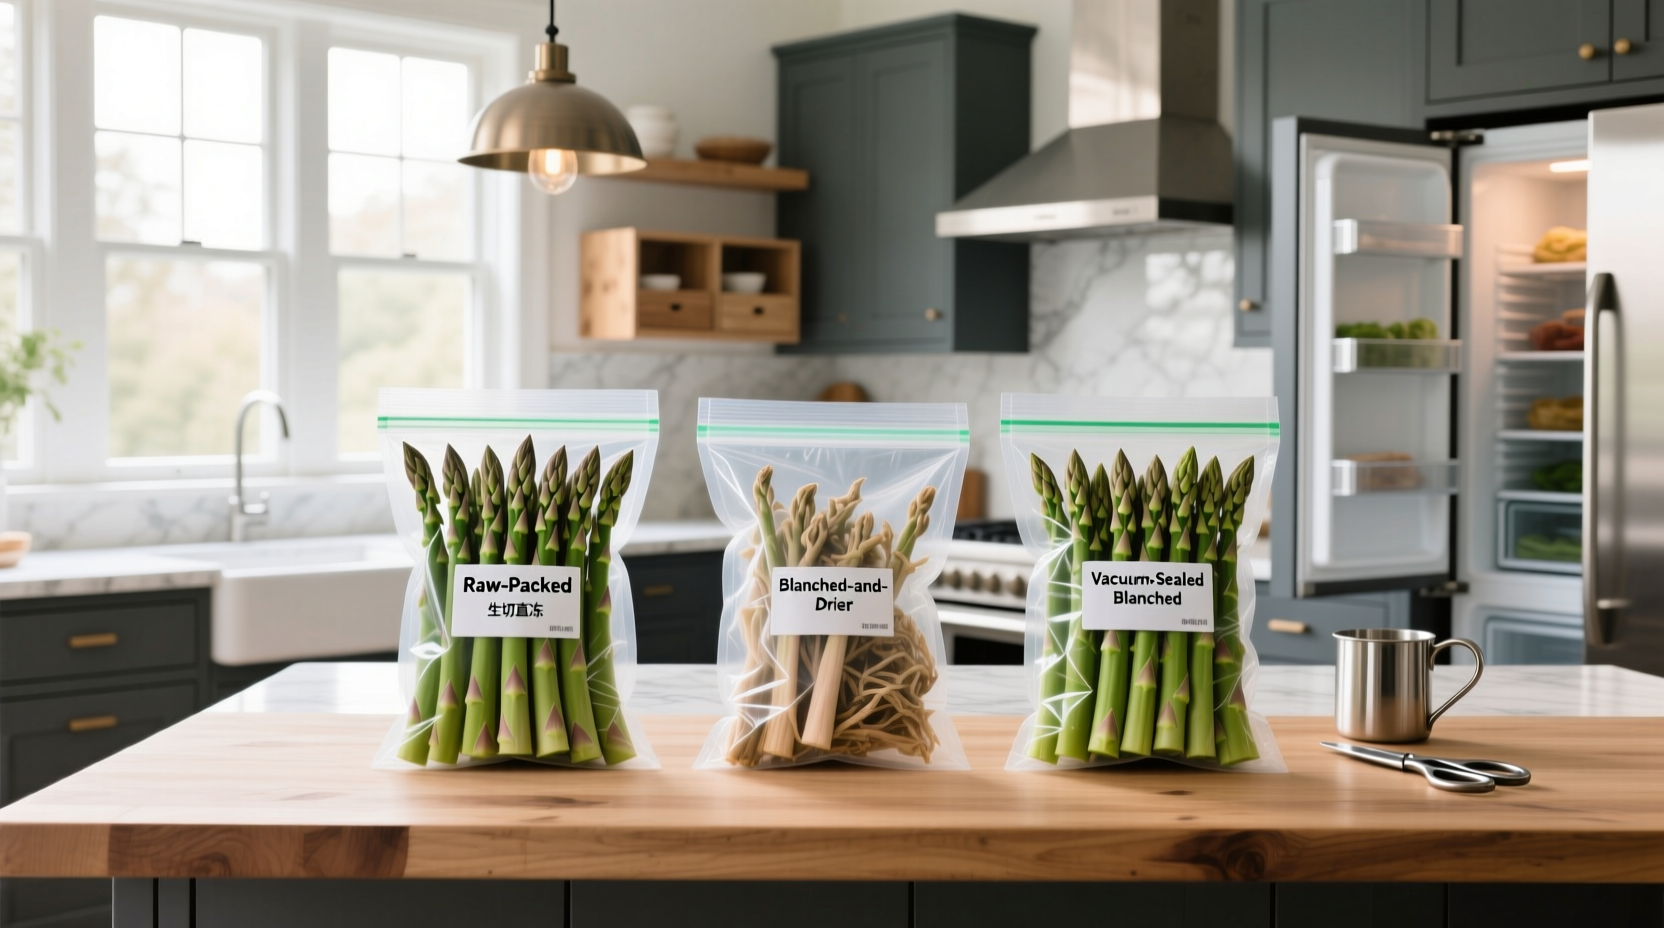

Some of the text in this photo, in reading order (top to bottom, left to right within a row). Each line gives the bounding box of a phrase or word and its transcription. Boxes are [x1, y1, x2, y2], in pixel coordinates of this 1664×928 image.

[463, 576, 572, 593] Raw-Packed
[779, 577, 888, 592] Blanched-and-
[815, 597, 854, 611] Drier
[1113, 590, 1182, 605] Blanched
